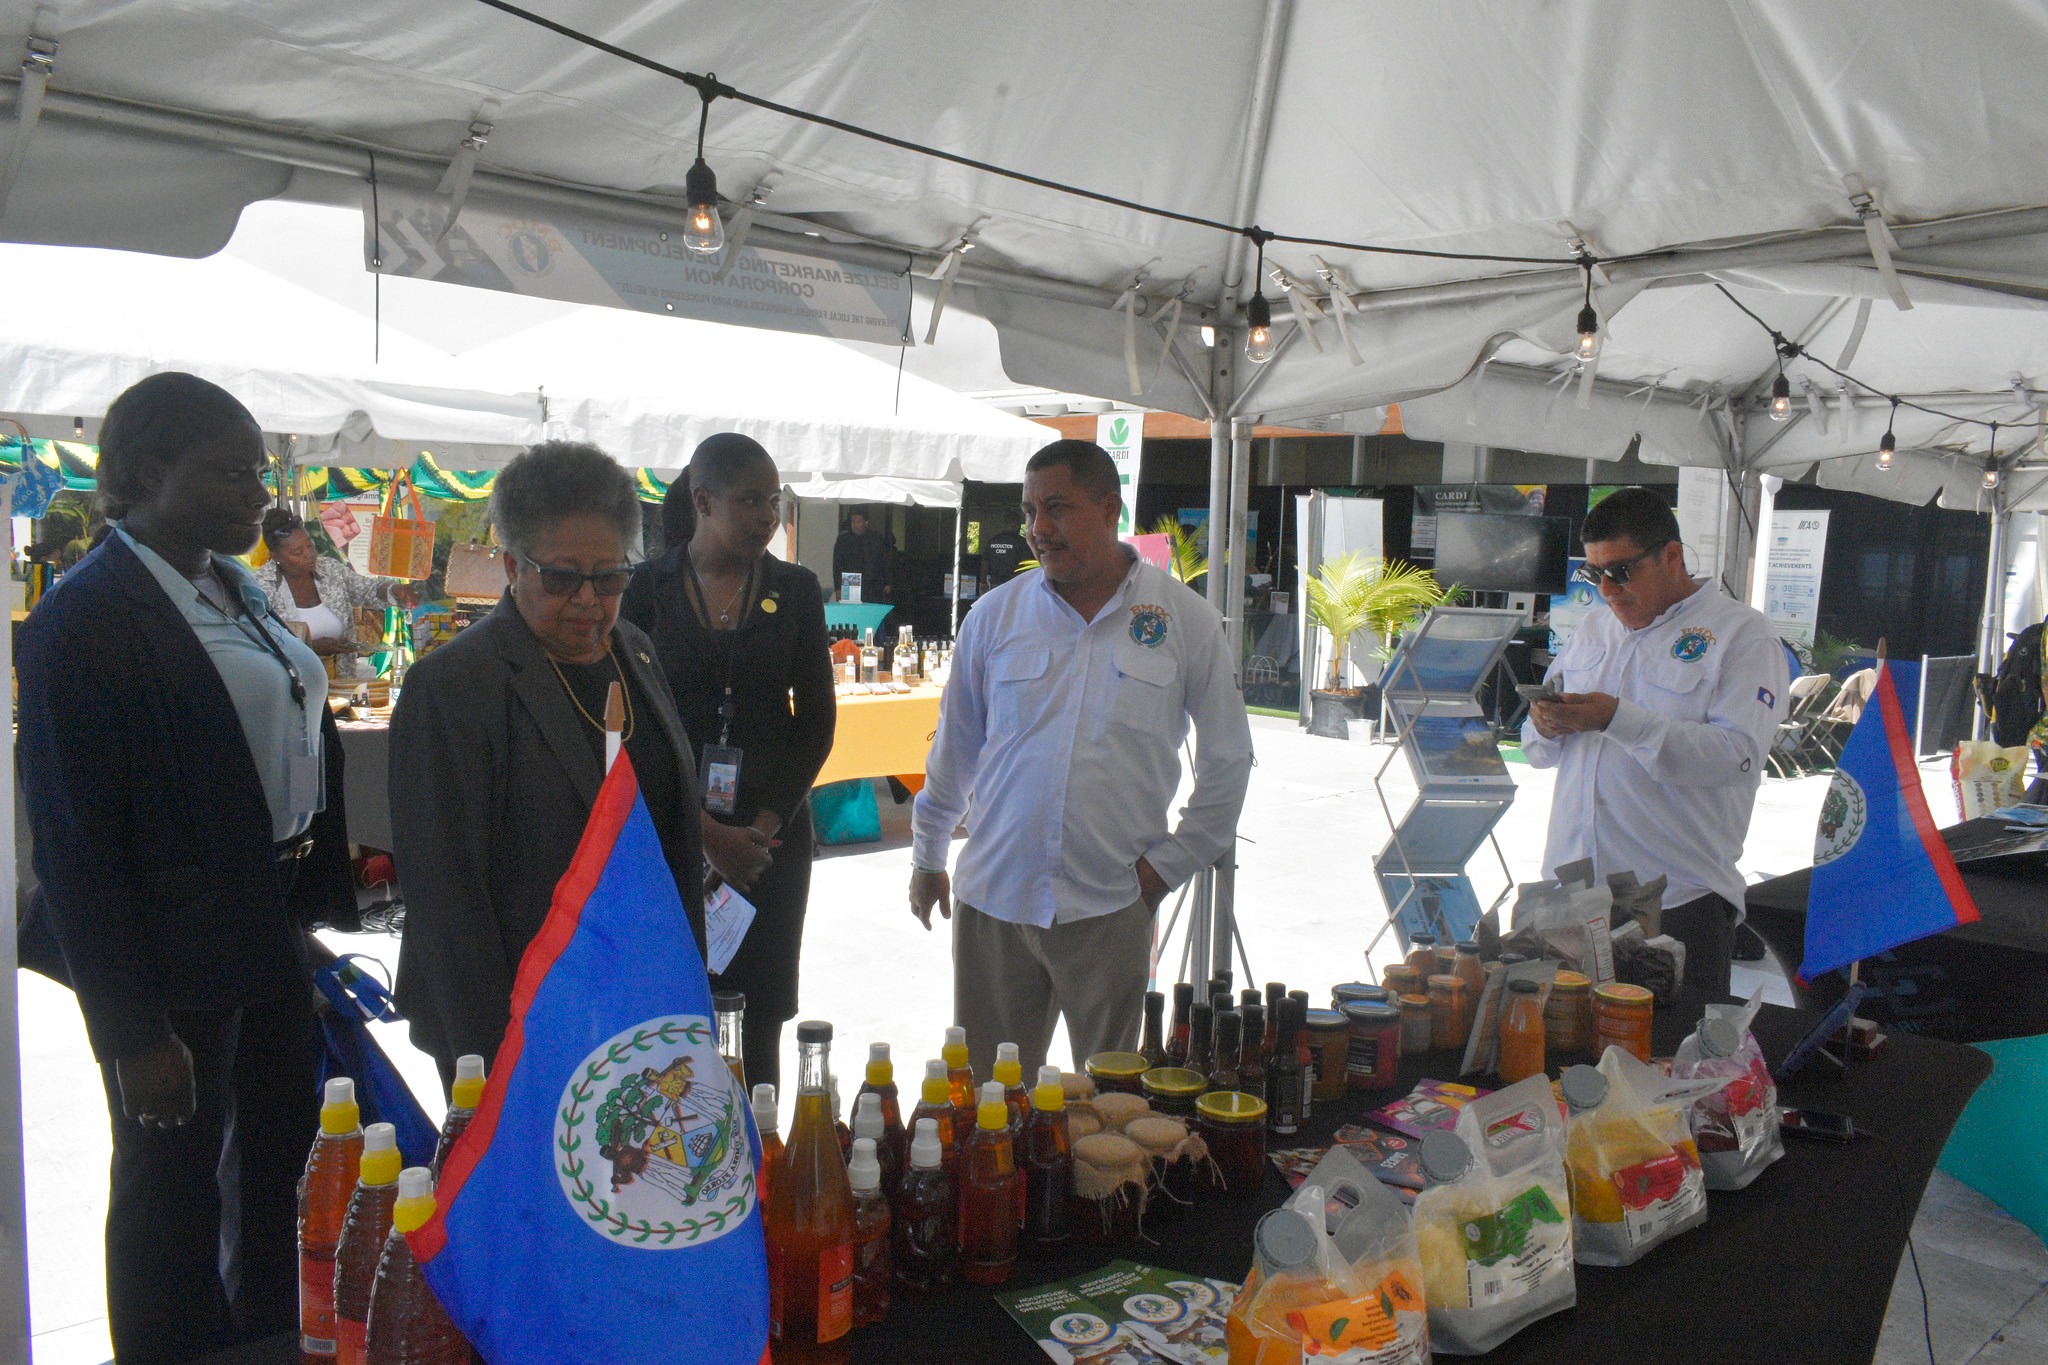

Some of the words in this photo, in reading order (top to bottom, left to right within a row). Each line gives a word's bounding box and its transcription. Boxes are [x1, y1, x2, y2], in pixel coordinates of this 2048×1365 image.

[1435, 491, 1468, 500] CARDI
[1015, 1294, 1068, 1309] DEVELOPMENT
[1019, 1289, 1068, 1303] ORPORATION
[1020, 1300, 1064, 1313] MARKETING
